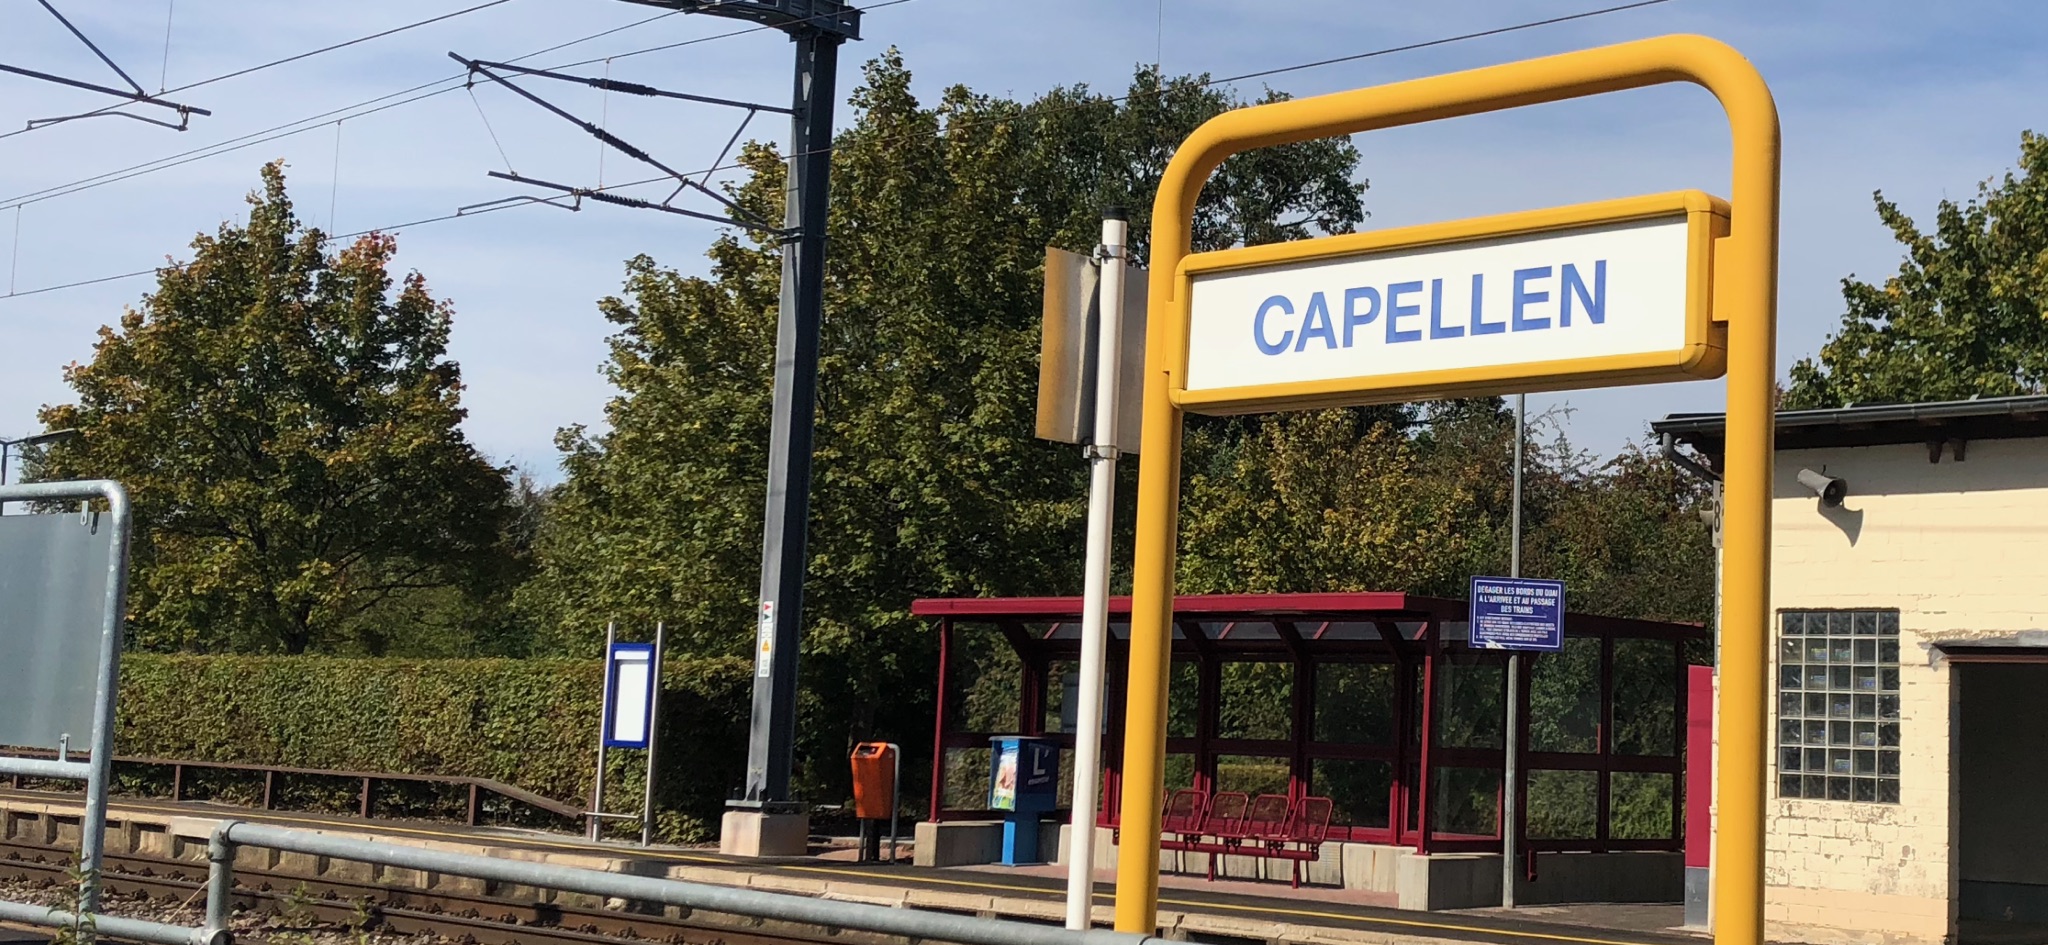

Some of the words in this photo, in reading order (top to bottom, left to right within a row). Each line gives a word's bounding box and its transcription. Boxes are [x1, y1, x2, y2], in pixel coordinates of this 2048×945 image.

[1253, 259, 1608, 356] CAPELLEN
[1504, 587, 1515, 595] LES
[1515, 587, 1534, 596] BORDS
[1535, 588, 1544, 597] DU
[1513, 596, 1521, 604] ET
[1521, 596, 1530, 605] AU
[1530, 597, 1556, 606] PASSAGE
[1501, 605, 1512, 613] DES
[1513, 606, 1534, 614] TRAINS
